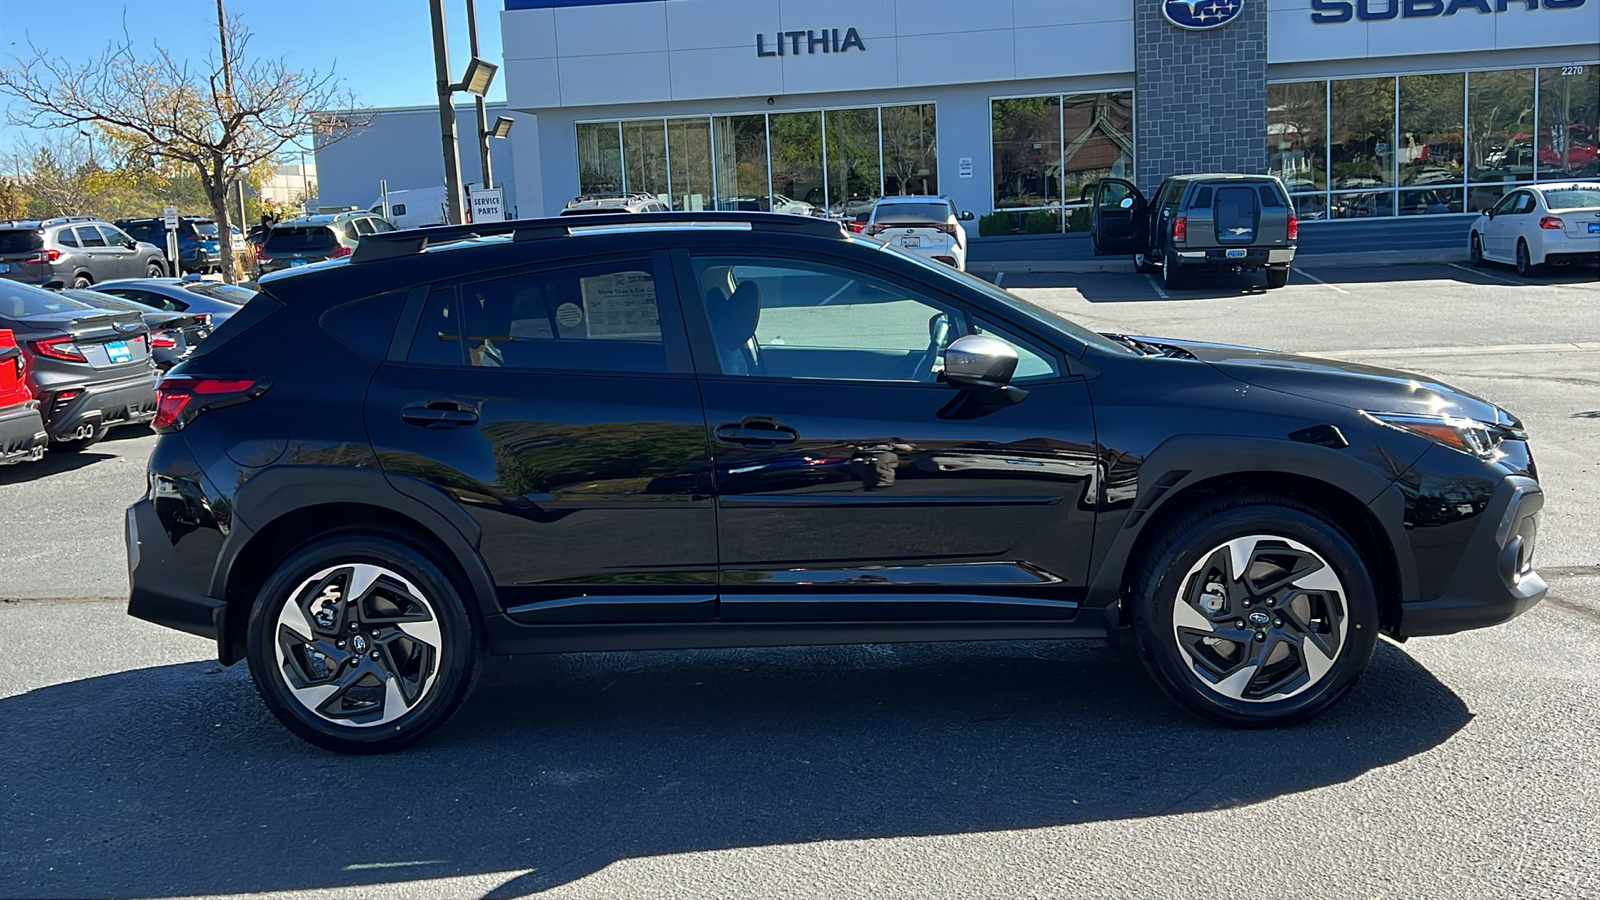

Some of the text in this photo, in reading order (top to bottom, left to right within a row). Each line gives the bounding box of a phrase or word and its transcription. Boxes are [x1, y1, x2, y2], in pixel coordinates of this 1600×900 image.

[1311, 0, 1587, 24] SUB
[756, 27, 866, 57] LITHIA
[1561, 66, 1583, 76] 2270
[474, 197, 500, 206] SERVICE
[478, 207, 499, 215] PARTS
